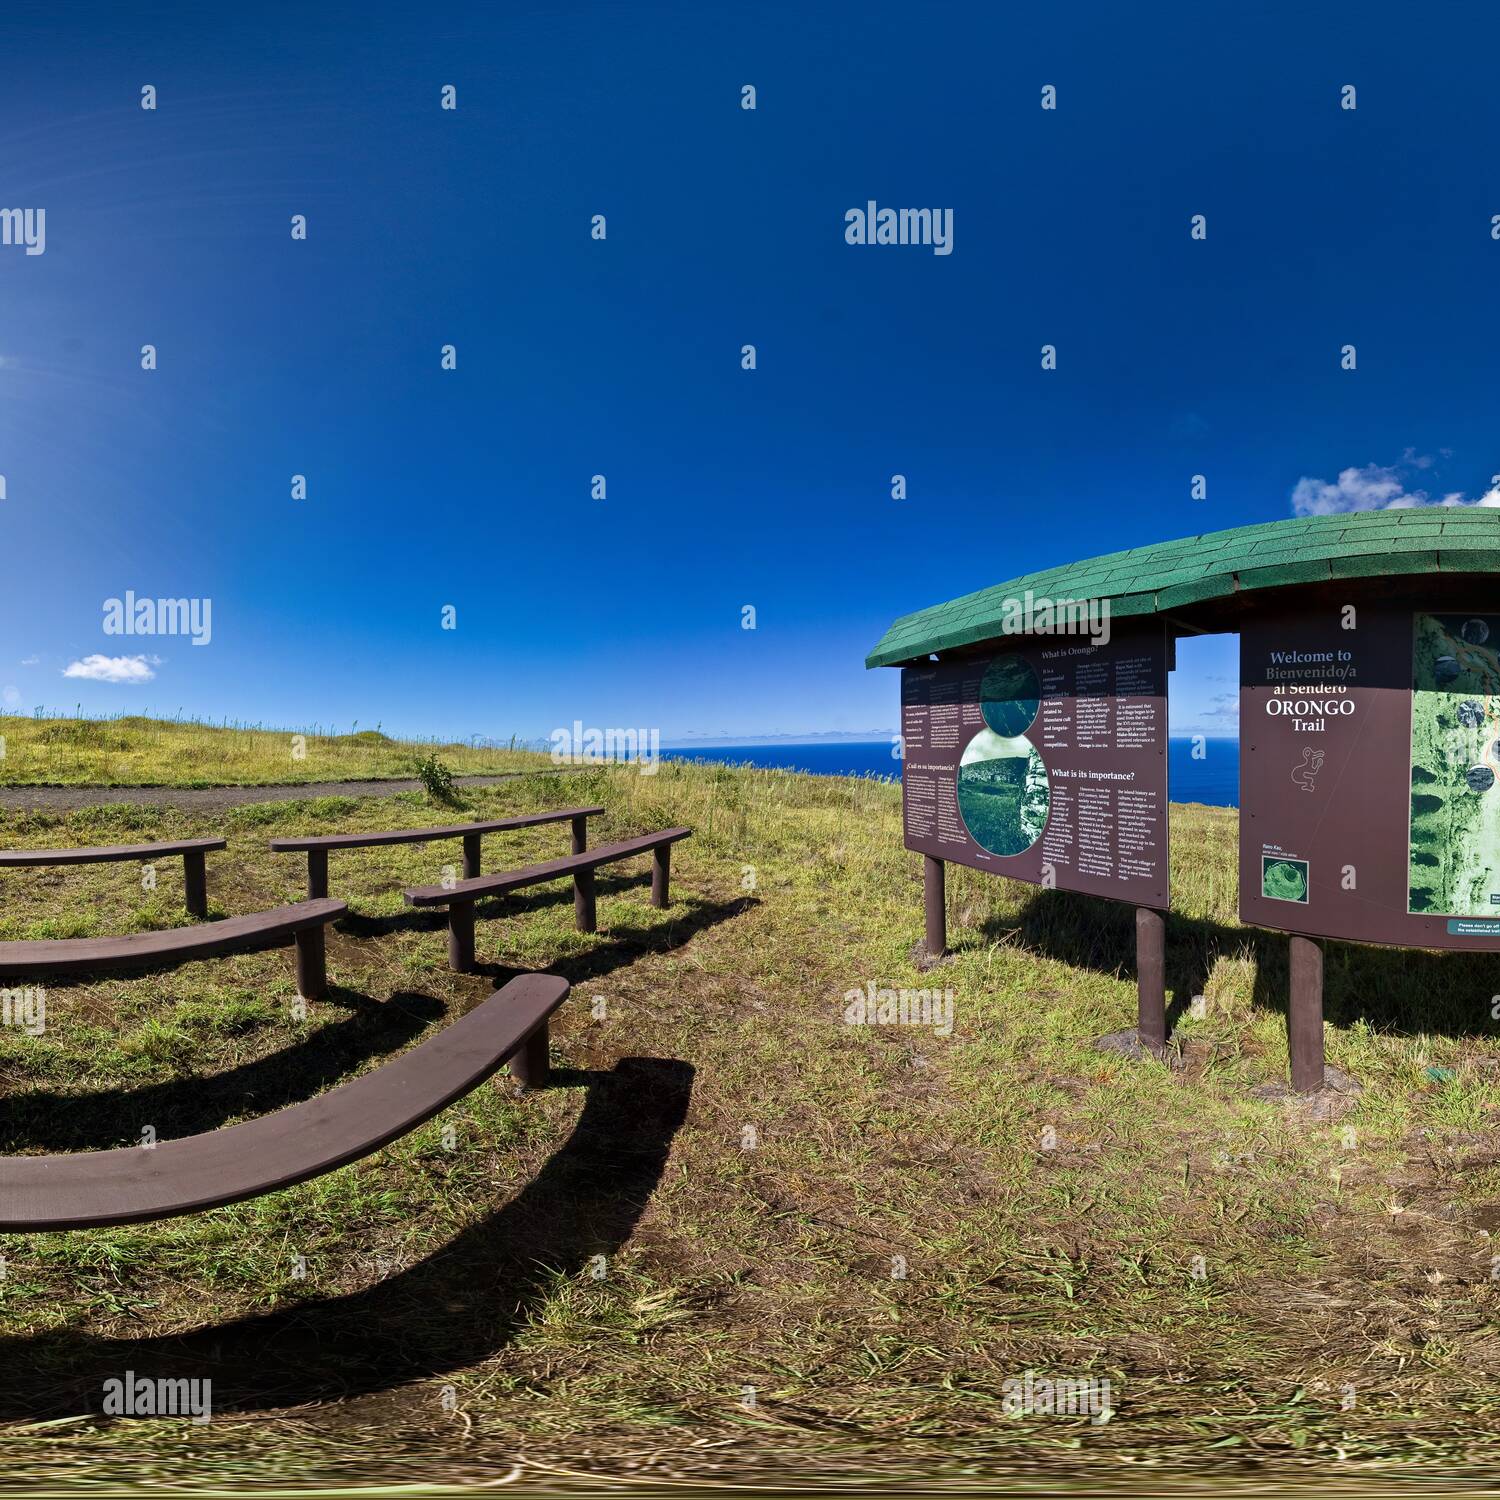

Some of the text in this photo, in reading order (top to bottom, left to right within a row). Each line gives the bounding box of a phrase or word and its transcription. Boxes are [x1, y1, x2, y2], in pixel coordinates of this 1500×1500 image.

[1041, 651, 1059, 659] What
[1068, 646, 1098, 657] Orongo?
[1271, 650, 1351, 664] Welcome to
[1266, 664, 1356, 680] Bienvenido/a
[1274, 682, 1346, 695] al Sendero
[1266, 699, 1355, 715] ORONGO
[1292, 718, 1325, 731] Trail
[1052, 768, 1134, 782] What is its importance?
